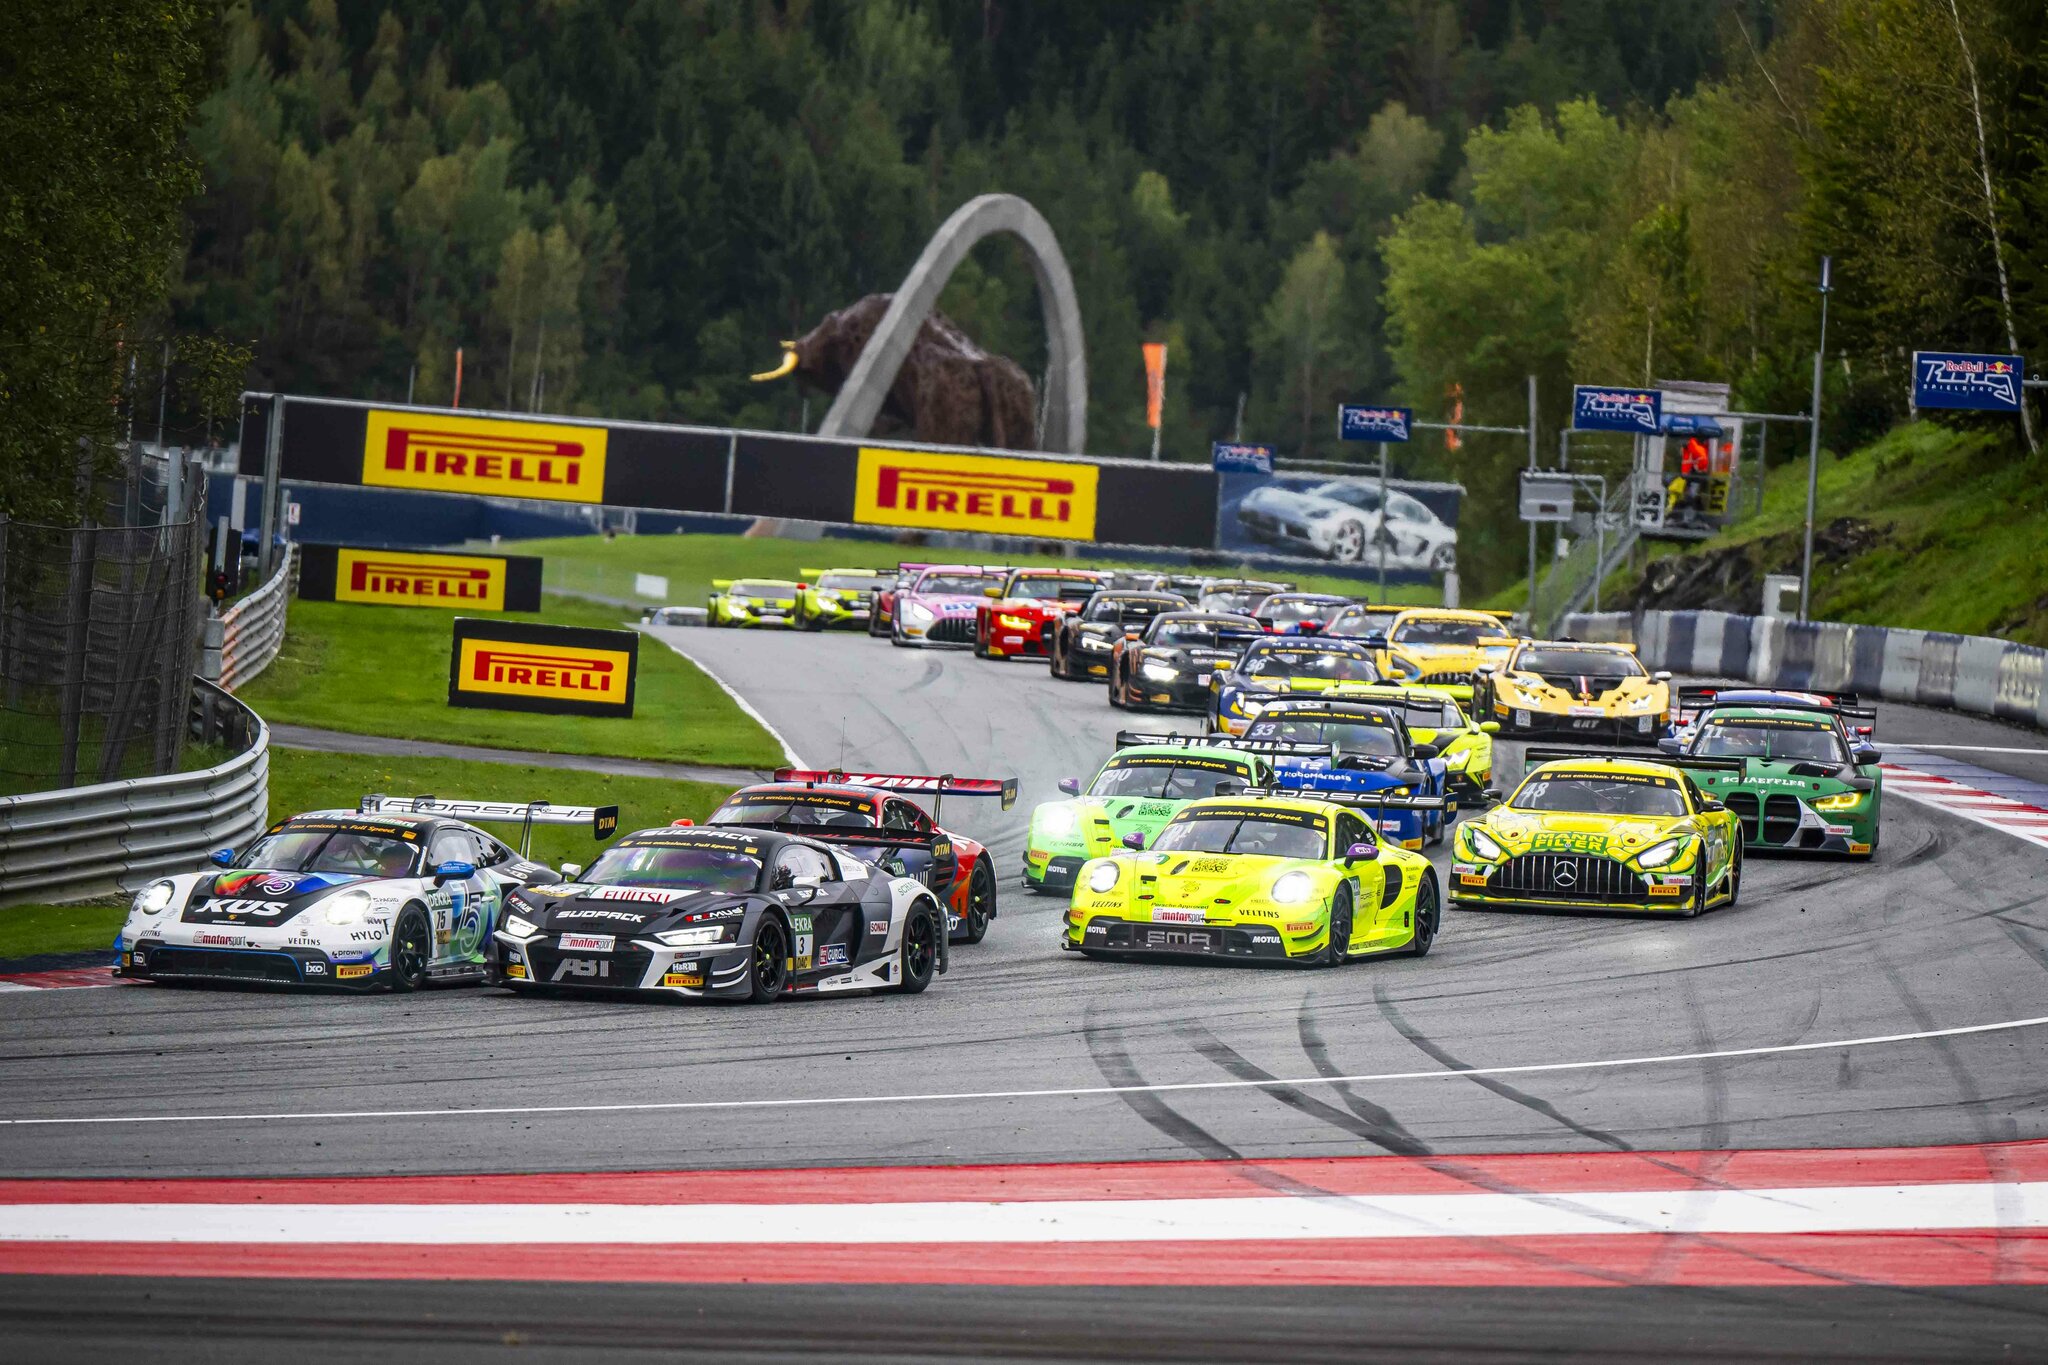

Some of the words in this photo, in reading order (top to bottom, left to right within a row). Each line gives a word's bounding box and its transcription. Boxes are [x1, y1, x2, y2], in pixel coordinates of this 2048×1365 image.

[1946, 360, 1965, 372] Red
[1965, 361, 1984, 373] Bull
[1921, 360, 2017, 405] Ring
[1923, 384, 1992, 392] SPIELBERG
[385, 427, 585, 485] PIRELLI
[876, 465, 1075, 522] PIRELLI
[351, 560, 491, 599] PIRELLI
[473, 650, 614, 691] PIRELLI
[1251, 724, 1276, 737] 33
[1201, 761, 1228, 769] Speed.
[1284, 771, 1351, 782] RoboMarkets
[1520, 781, 1549, 798] 48
[1242, 788, 1443, 804] PORSCHE
[824, 798, 851, 807] Speed.
[385, 800, 596, 818] PORSCHE
[599, 816, 615, 830] DTM
[1275, 813, 1303, 822] Speed.
[367, 825, 396, 834] Speed.
[1535, 833, 1604, 843] MANN
[934, 844, 950, 857] DTM
[1534, 840, 1603, 851] FILTER
[891, 861, 906, 875] EKRA
[1047, 865, 1068, 874] MOTUL
[1462, 877, 1485, 885] PIRELLI
[1651, 886, 1677, 895] PIRELLI
[428, 891, 453, 907] DEKRA
[1091, 900, 1123, 908] VELTINS
[1162, 911, 1205, 923] motorsport
[1239, 909, 1280, 919] VELTINS
[436, 911, 446, 930] 75
[794, 916, 813, 931] EKRA
[870, 923, 887, 933] SONAX
[1087, 926, 1107, 934] MOTUL
[1286, 922, 1313, 931] PIRELLI
[202, 934, 247, 947] motorsport
[350, 930, 383, 941] HYLO
[1147, 931, 1211, 946] EMA
[1252, 936, 1281, 944] MOTUL
[288, 937, 321, 946] VELTINS
[569, 938, 614, 949] motorsport
[799, 937, 805, 954] 3
[827, 948, 847, 960] GURGL
[796, 957, 808, 969] DAC
[340, 967, 371, 976] PIRELLI
[667, 976, 700, 985] PIRELLI
